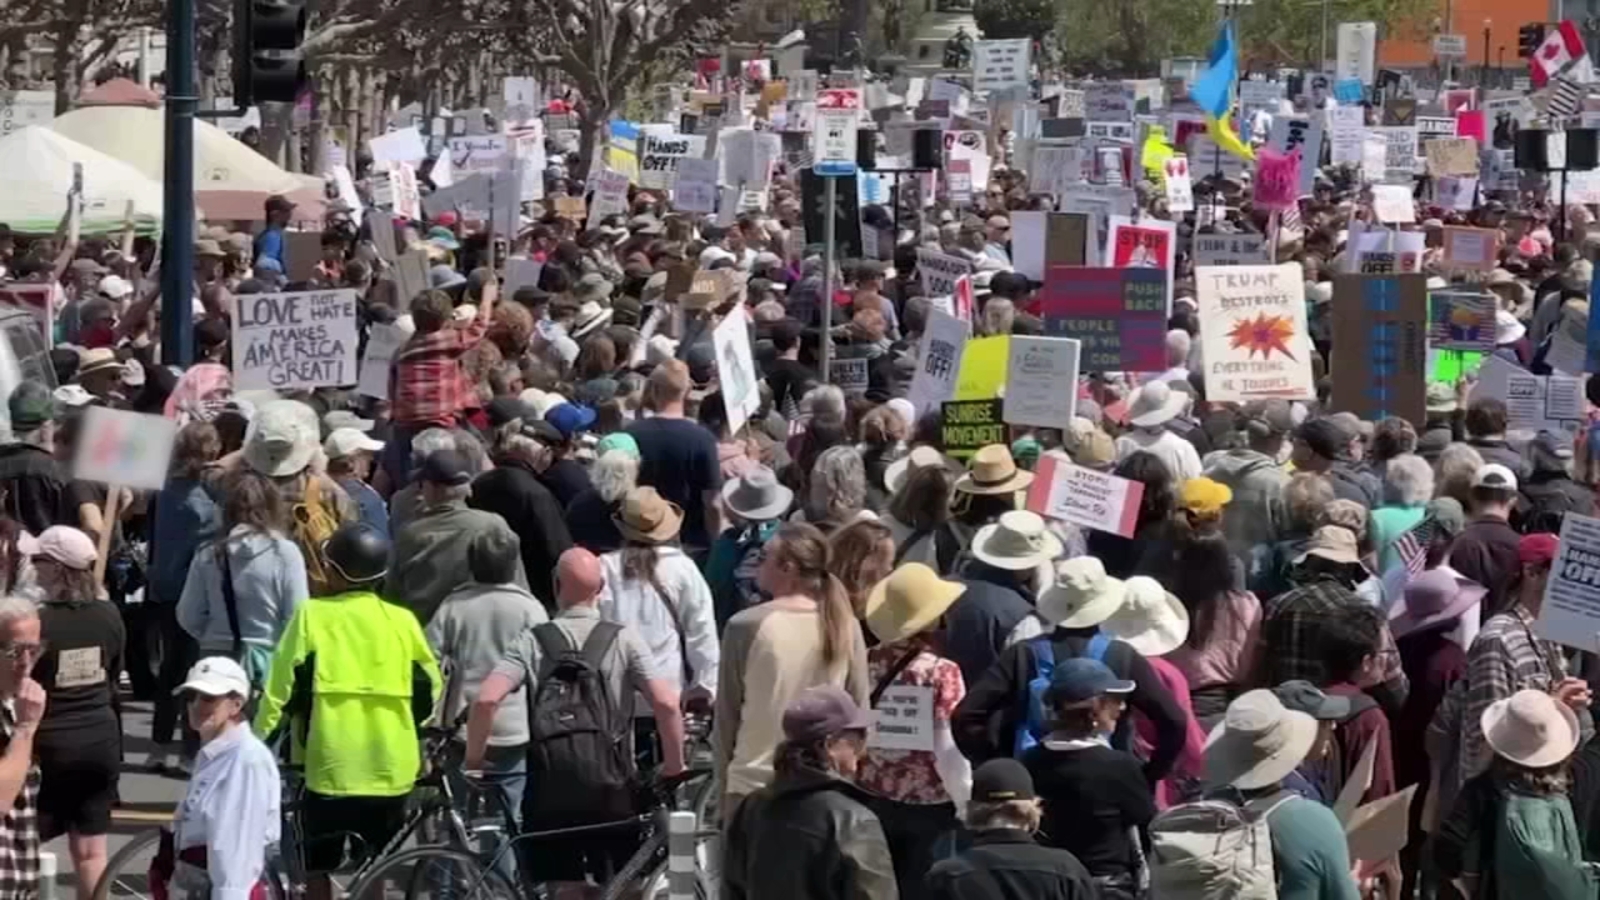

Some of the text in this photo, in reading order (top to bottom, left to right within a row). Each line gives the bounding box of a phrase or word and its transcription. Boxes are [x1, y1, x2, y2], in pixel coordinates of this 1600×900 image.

[647, 138, 690, 154] HANDS
[1120, 229, 1161, 248] STOP
[1124, 283, 1164, 295] PUSH
[1211, 273, 1279, 291] TRUMP
[1124, 299, 1164, 311] BACK
[1220, 295, 1289, 308] DESTROYS
[238, 297, 302, 328] LOVE
[311, 302, 354, 320] HATE
[1059, 319, 1115, 331] PEOPLE
[270, 325, 327, 346] MAKES
[243, 340, 345, 369] AMERICA
[268, 360, 343, 386] GREAT!
[1213, 360, 1285, 374] EVERYTHING
[1243, 378, 1289, 390] TOUCHES
[945, 403, 994, 423] SUNRISE
[943, 424, 1003, 445] MOVEMENT
